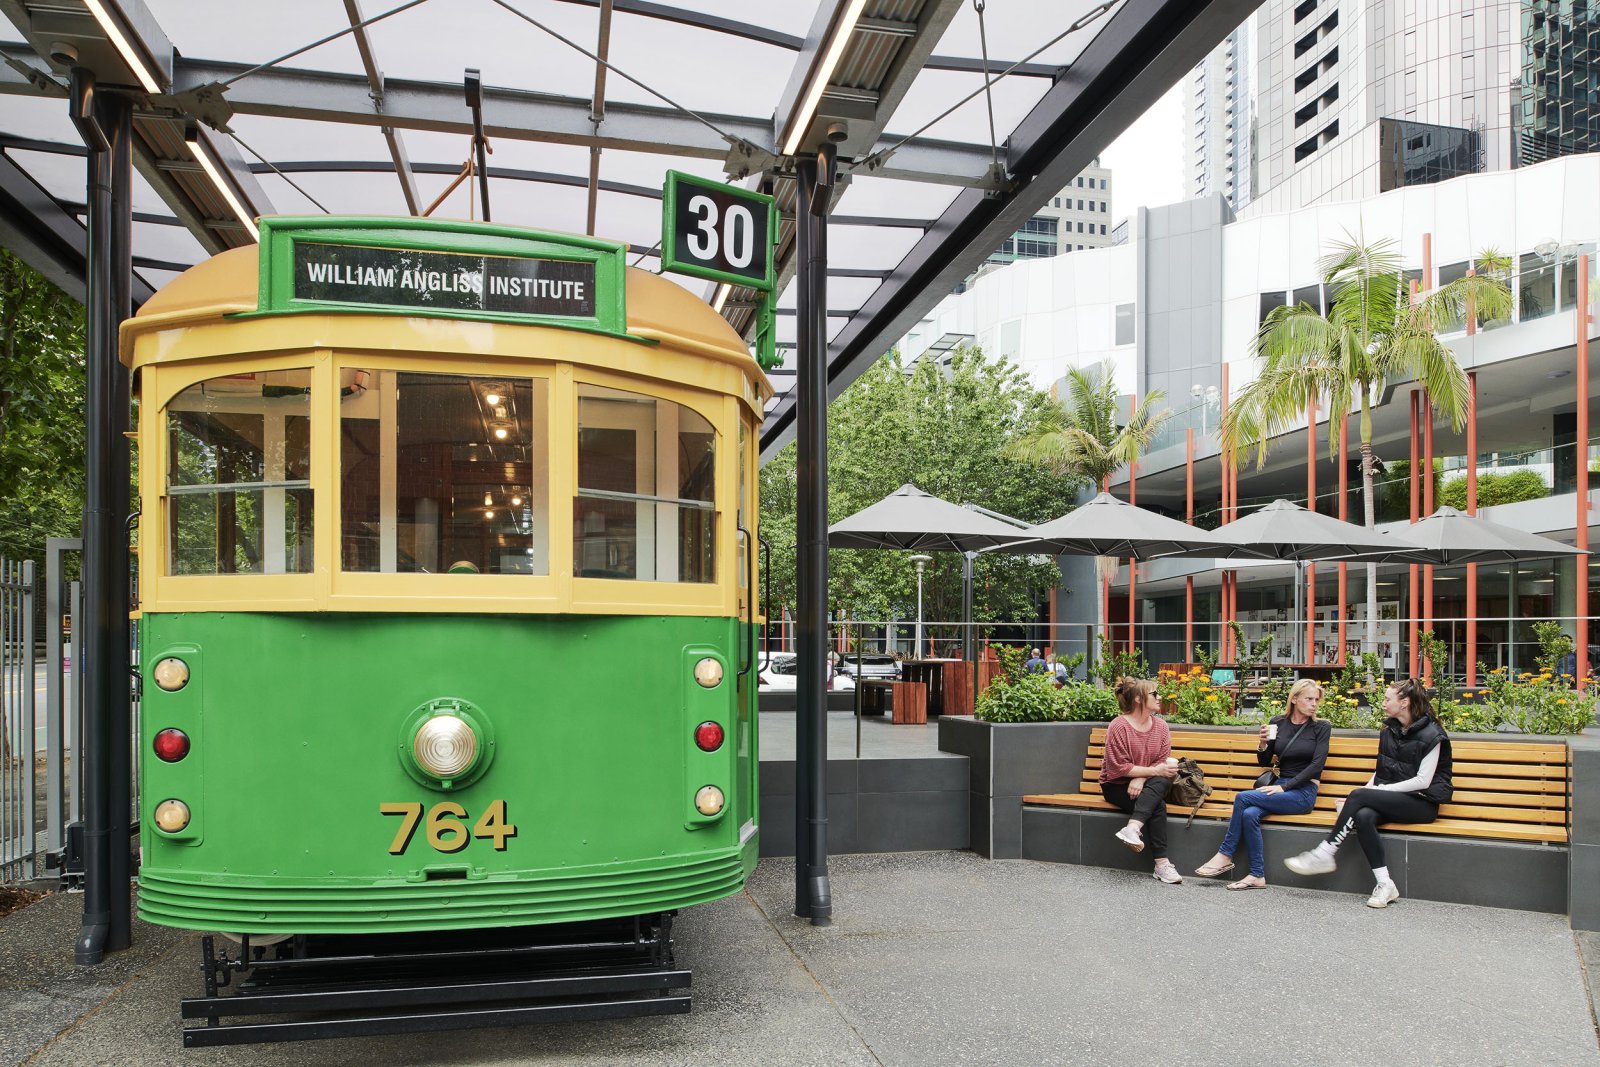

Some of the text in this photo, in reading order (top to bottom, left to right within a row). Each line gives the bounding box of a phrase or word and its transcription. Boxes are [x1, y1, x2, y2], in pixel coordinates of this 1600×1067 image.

[687, 195, 754, 269] 30
[307, 262, 585, 300] WILLIAM ANGLISS INSTITUTE
[379, 799, 518, 856] 764
[1329, 816, 1355, 849] NIKE
